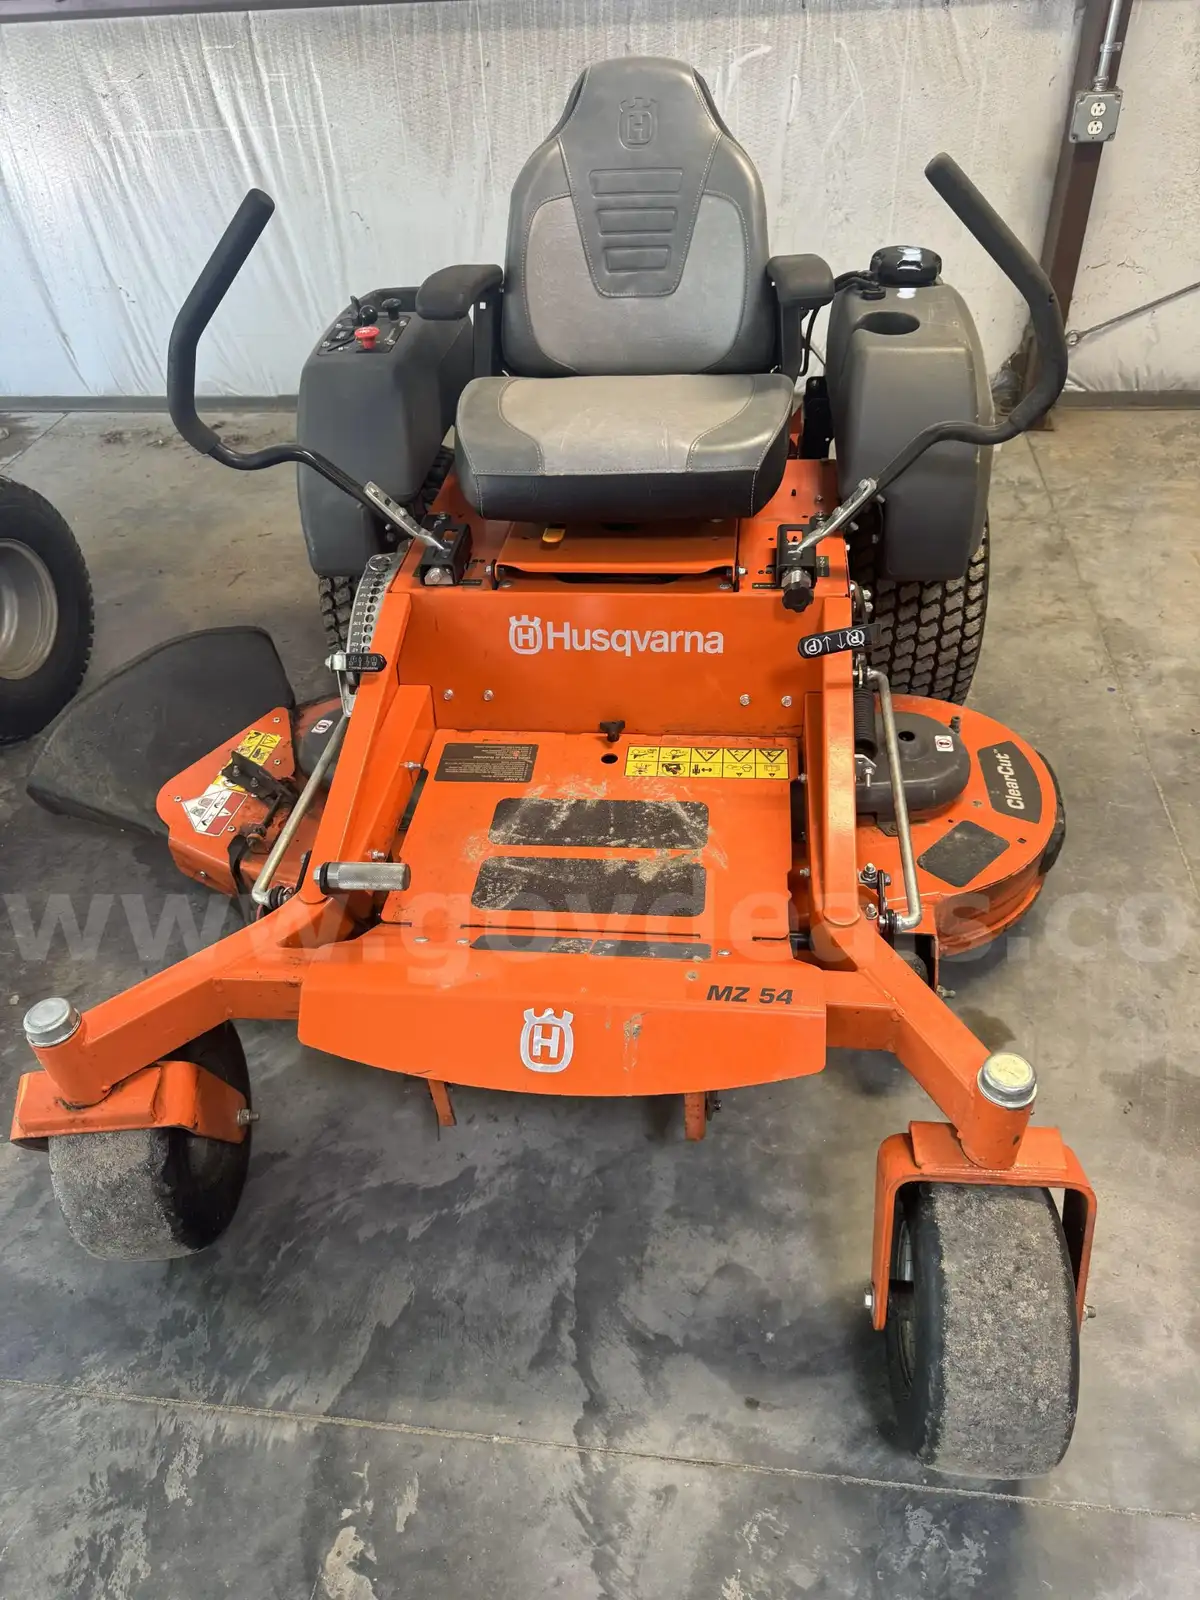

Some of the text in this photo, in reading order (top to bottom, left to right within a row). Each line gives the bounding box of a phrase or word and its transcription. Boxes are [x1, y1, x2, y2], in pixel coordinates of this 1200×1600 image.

[546, 621, 724, 657] Husqvarna
[706, 984, 794, 1005] MZ 54
